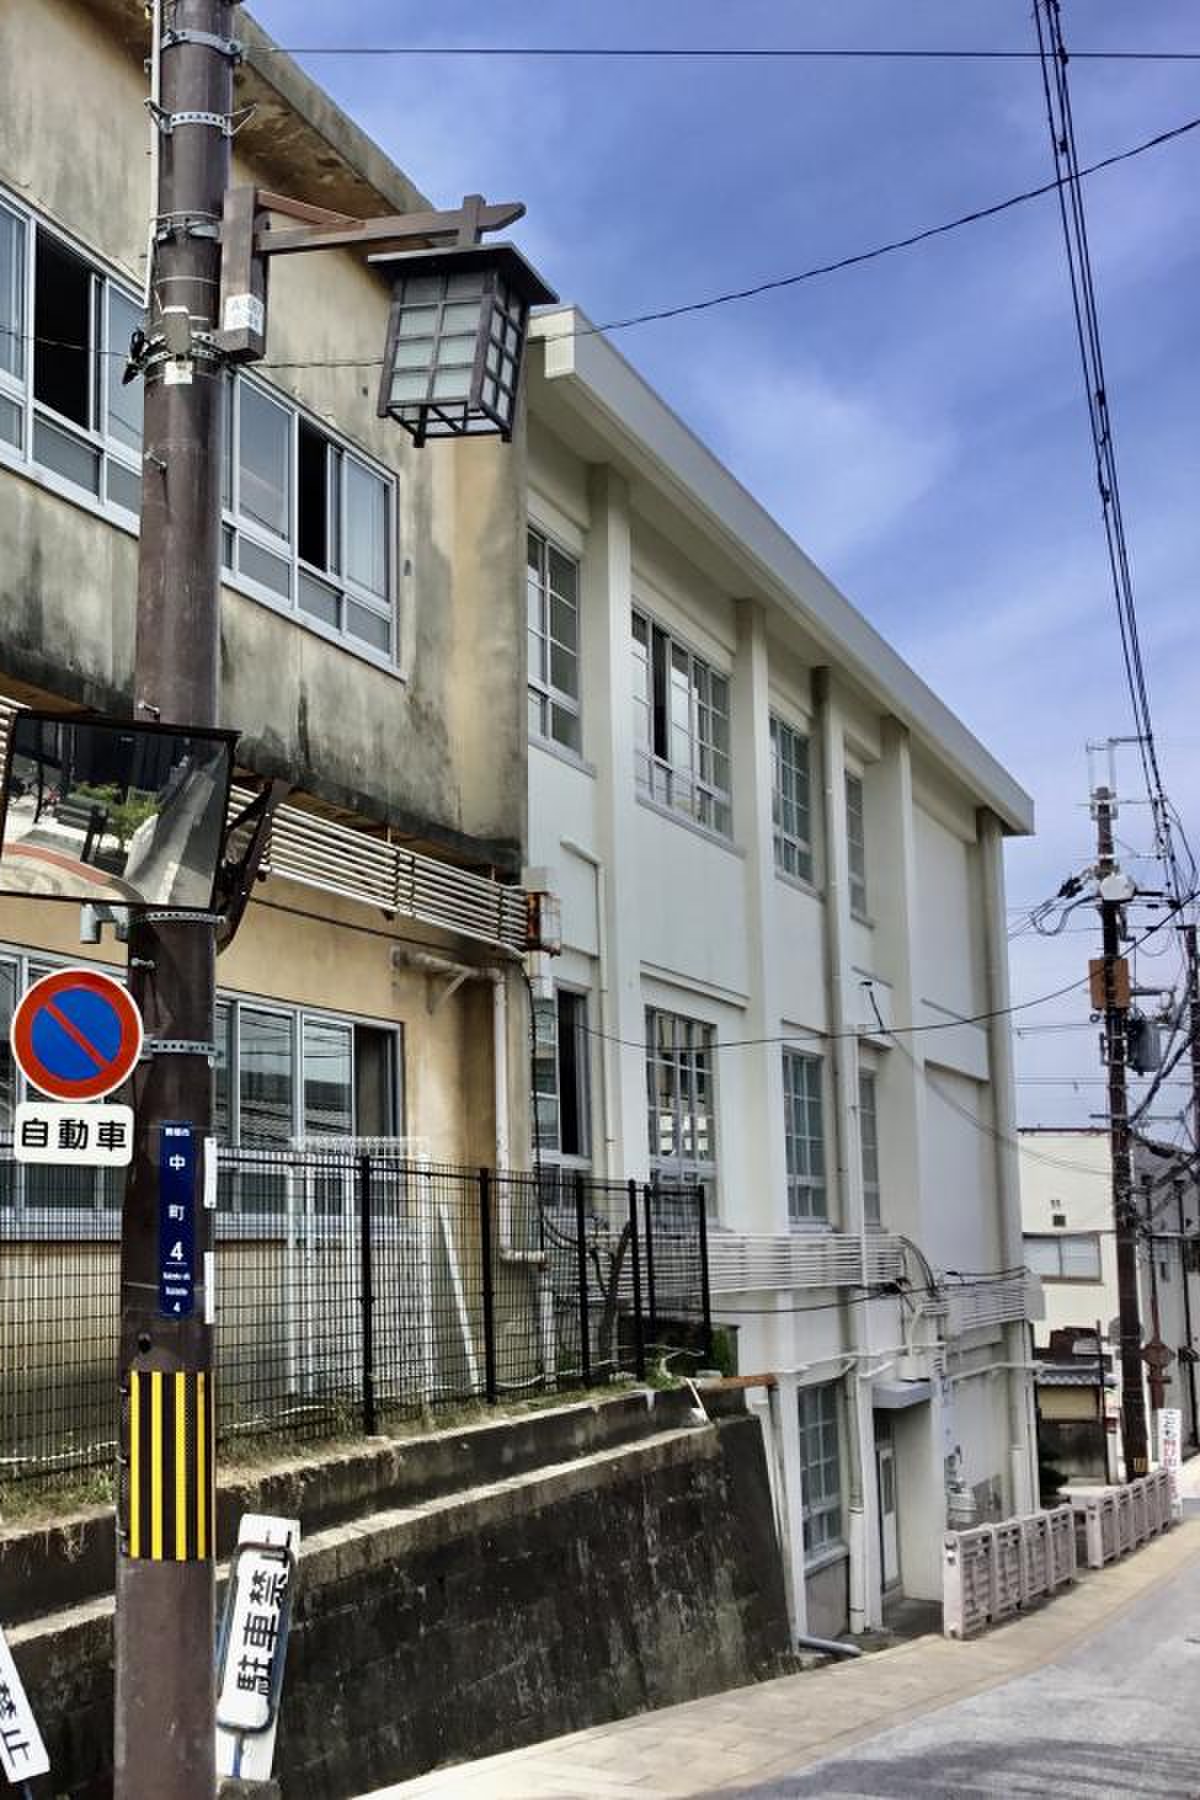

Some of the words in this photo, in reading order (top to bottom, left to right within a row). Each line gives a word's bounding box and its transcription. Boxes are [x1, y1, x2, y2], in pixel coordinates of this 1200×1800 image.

[21, 1117, 127, 1152] 自動車
[236, 1530, 292, 1697] 駐車禁止
